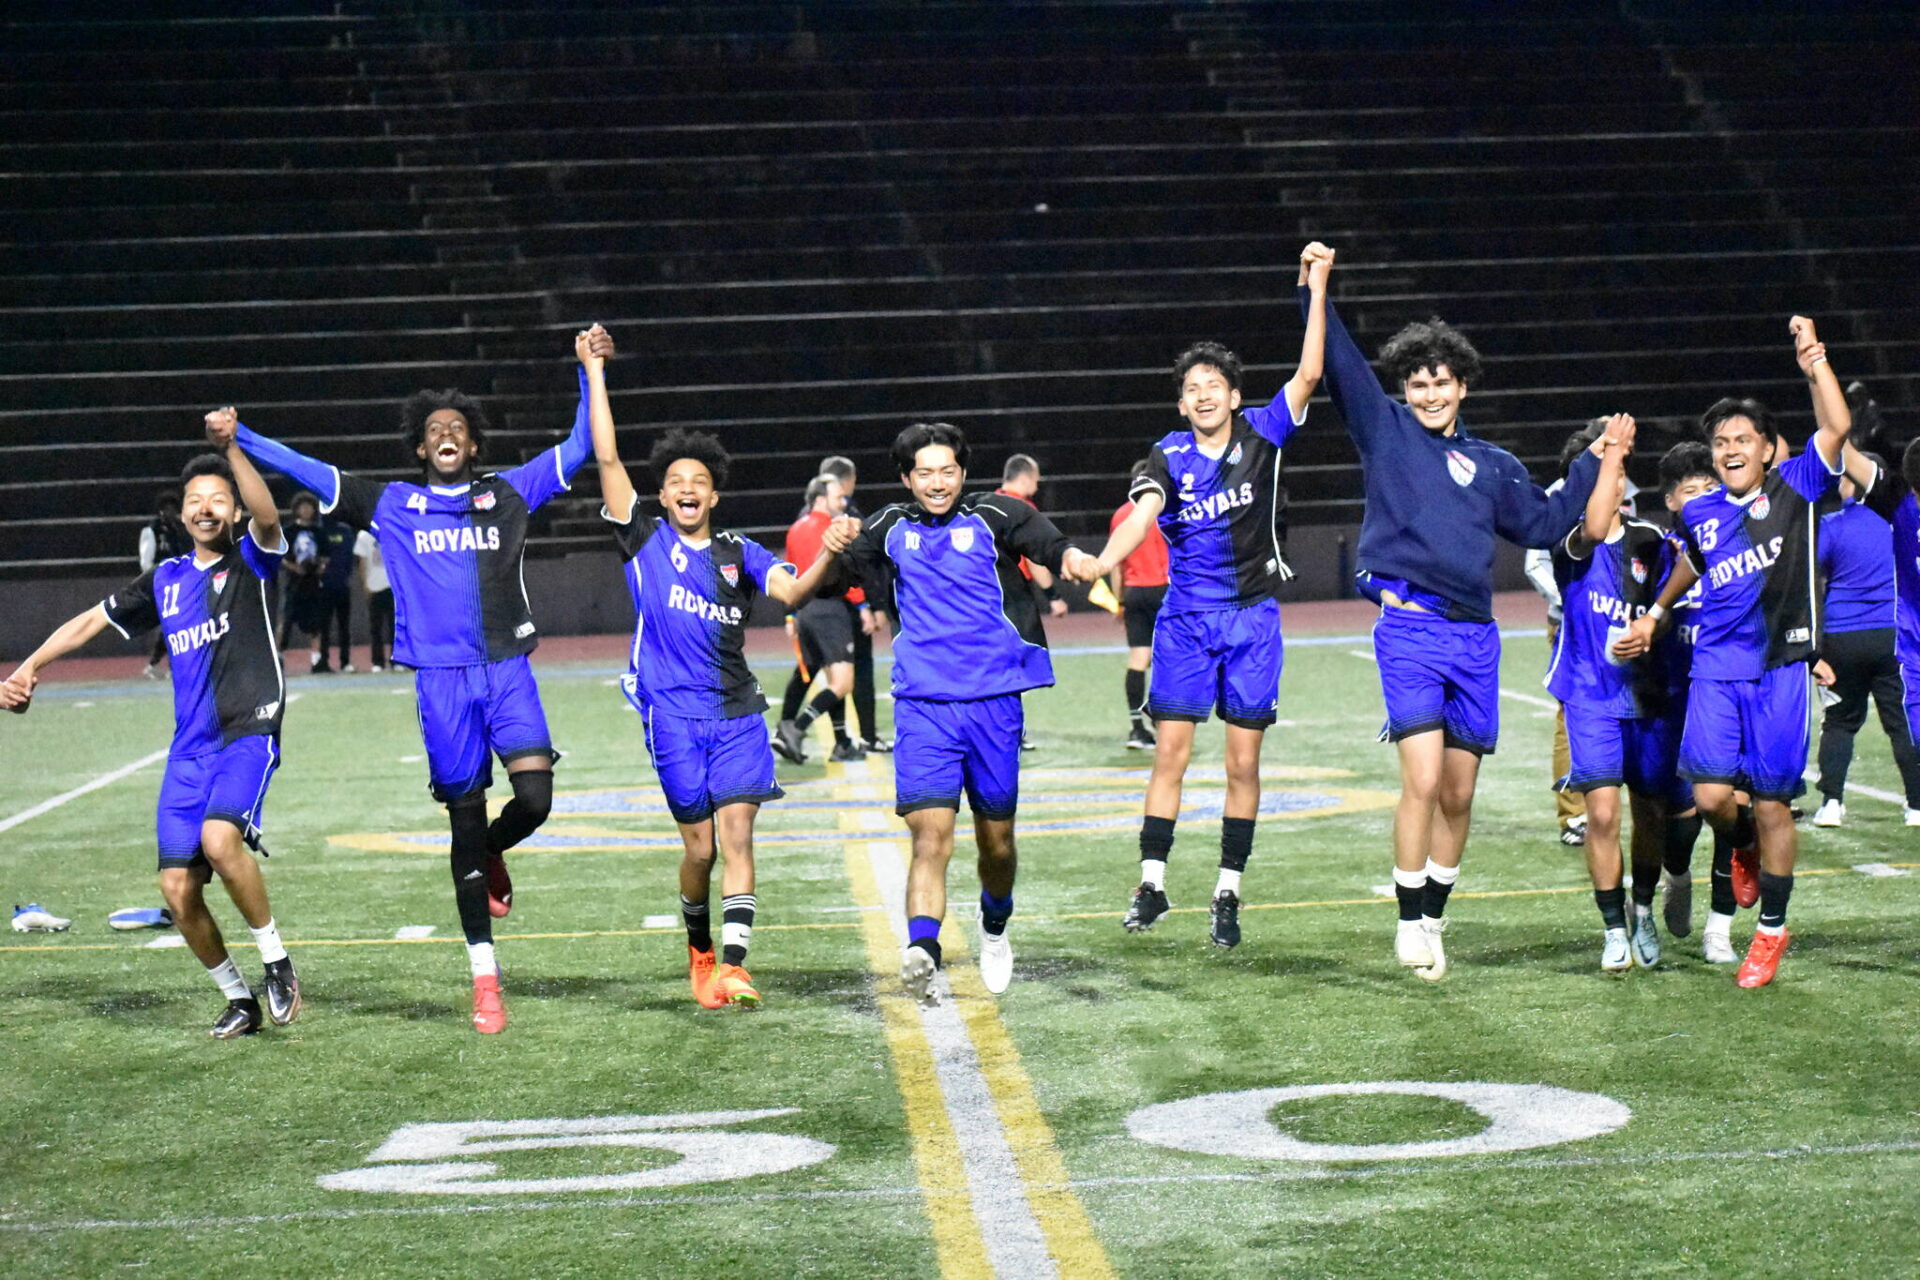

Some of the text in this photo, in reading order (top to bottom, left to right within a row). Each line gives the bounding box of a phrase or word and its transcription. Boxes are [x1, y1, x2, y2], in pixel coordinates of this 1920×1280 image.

[406, 492, 428, 515] 4
[1178, 473, 1196, 502] 2
[414, 526, 500, 554] ROYALS
[904, 530, 921, 551] 10
[1694, 518, 1719, 553] 13
[670, 541, 689, 573] 6
[1709, 536, 1783, 590] ROYALS
[162, 582, 180, 619] 11
[168, 611, 230, 656] ROYALS
